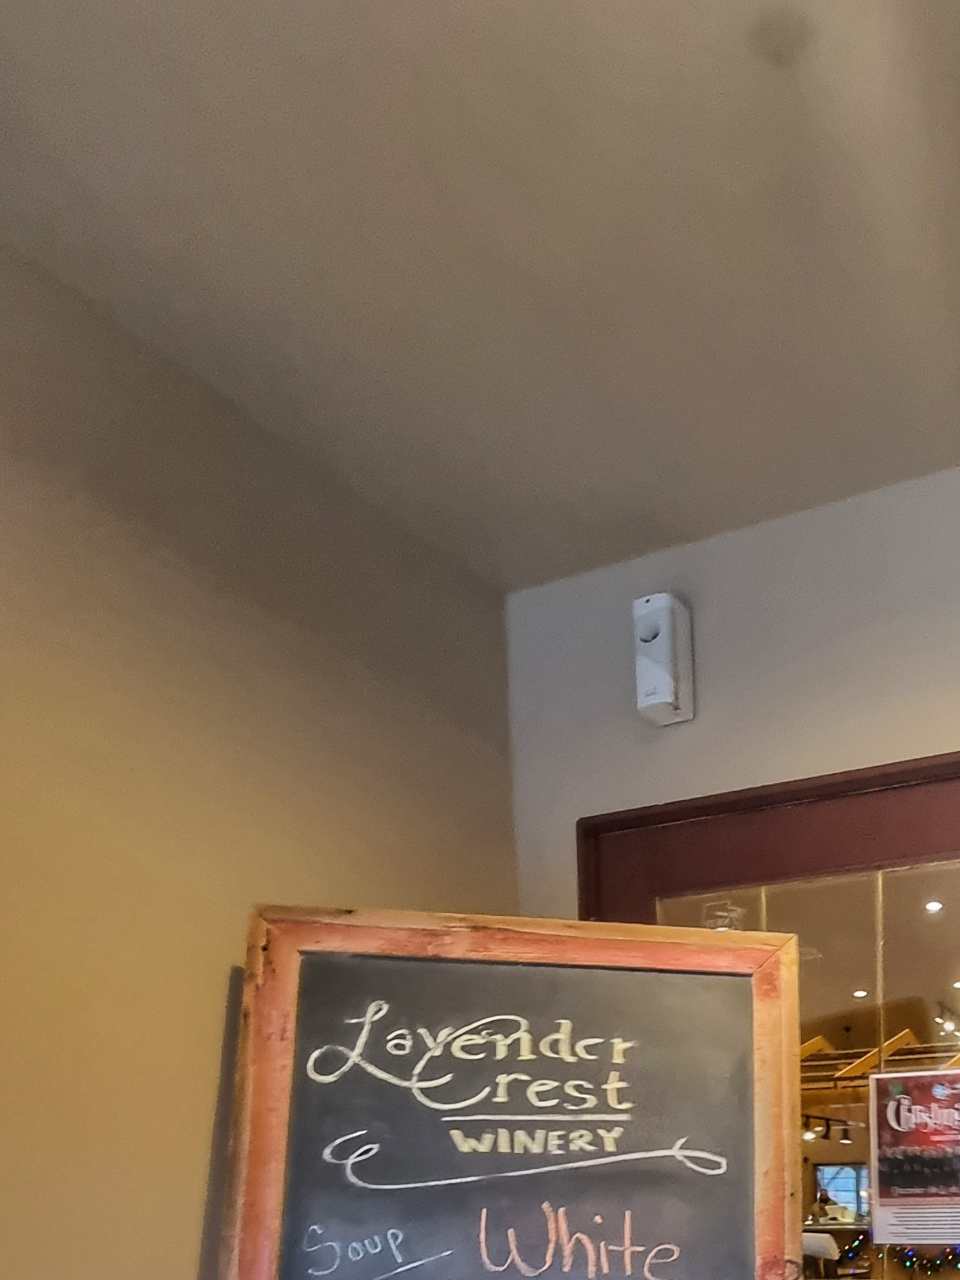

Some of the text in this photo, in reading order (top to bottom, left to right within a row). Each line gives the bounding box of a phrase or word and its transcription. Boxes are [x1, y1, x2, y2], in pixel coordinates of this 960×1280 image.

[307, 1000, 638, 1088] Lavender
[411, 1055, 638, 1111] Crest
[448, 1125, 625, 1155] WINERY
[302, 1224, 405, 1276] Soup
